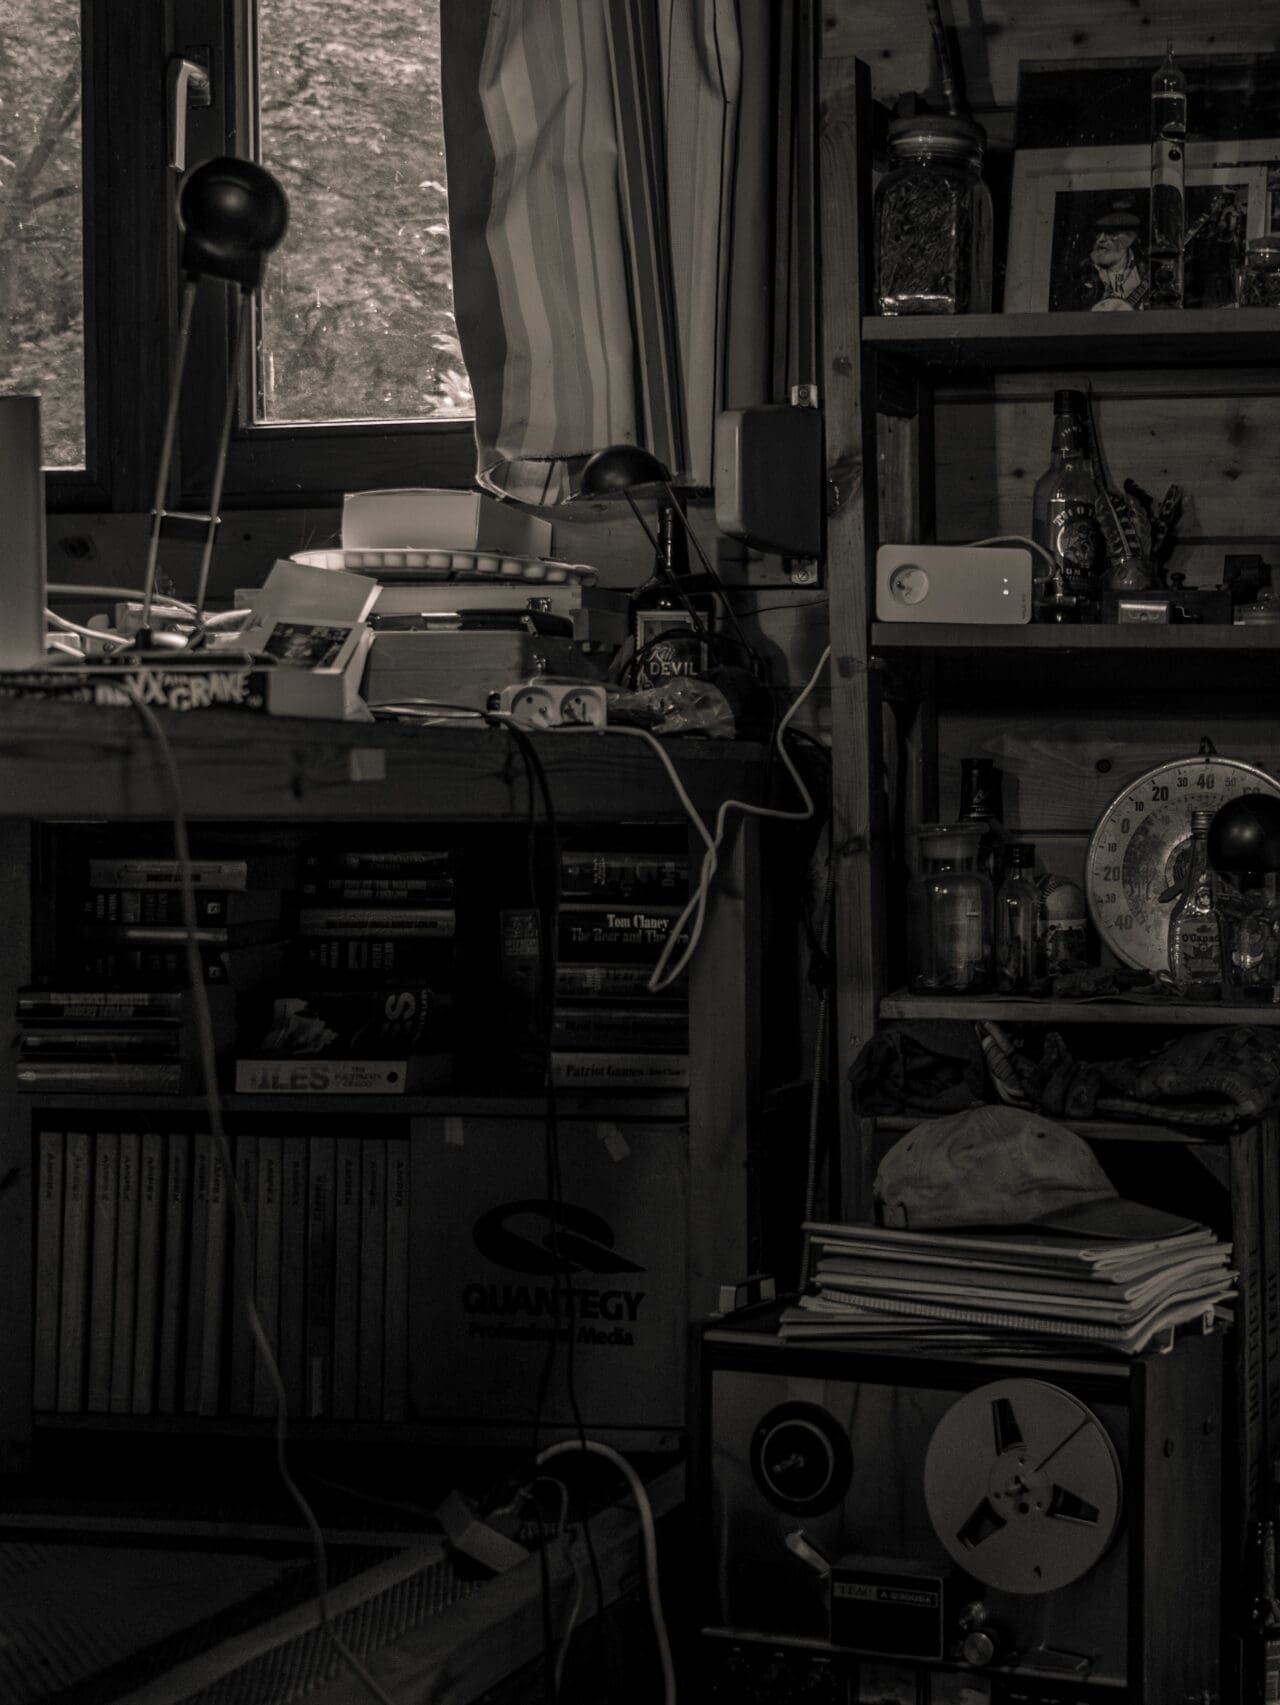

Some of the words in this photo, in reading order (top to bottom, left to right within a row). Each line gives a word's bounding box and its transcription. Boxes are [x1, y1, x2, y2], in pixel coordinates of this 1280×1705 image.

[650, 661, 699, 676] DEVIL
[1177, 777, 1189, 788] 30
[1196, 773, 1215, 789] 40
[1225, 777, 1237, 788] 50
[1151, 786, 1169, 802] 20
[1134, 801, 1145, 812] 10
[1121, 818, 1130, 834] 0
[1107, 843, 1117, 852] 10
[1103, 866, 1121, 882] 20
[1106, 893, 1117, 904] 30
[606, 913, 632, 928] Tom
[633, 913, 670, 932] Clancy
[1114, 915, 1133, 931] 40
[570, 928, 591, 942] The
[644, 929, 666, 943] The
[566, 1063, 605, 1078] Patriot
[461, 1282, 645, 1321] QUANTEGY
[577, 1326, 634, 1346] Media
